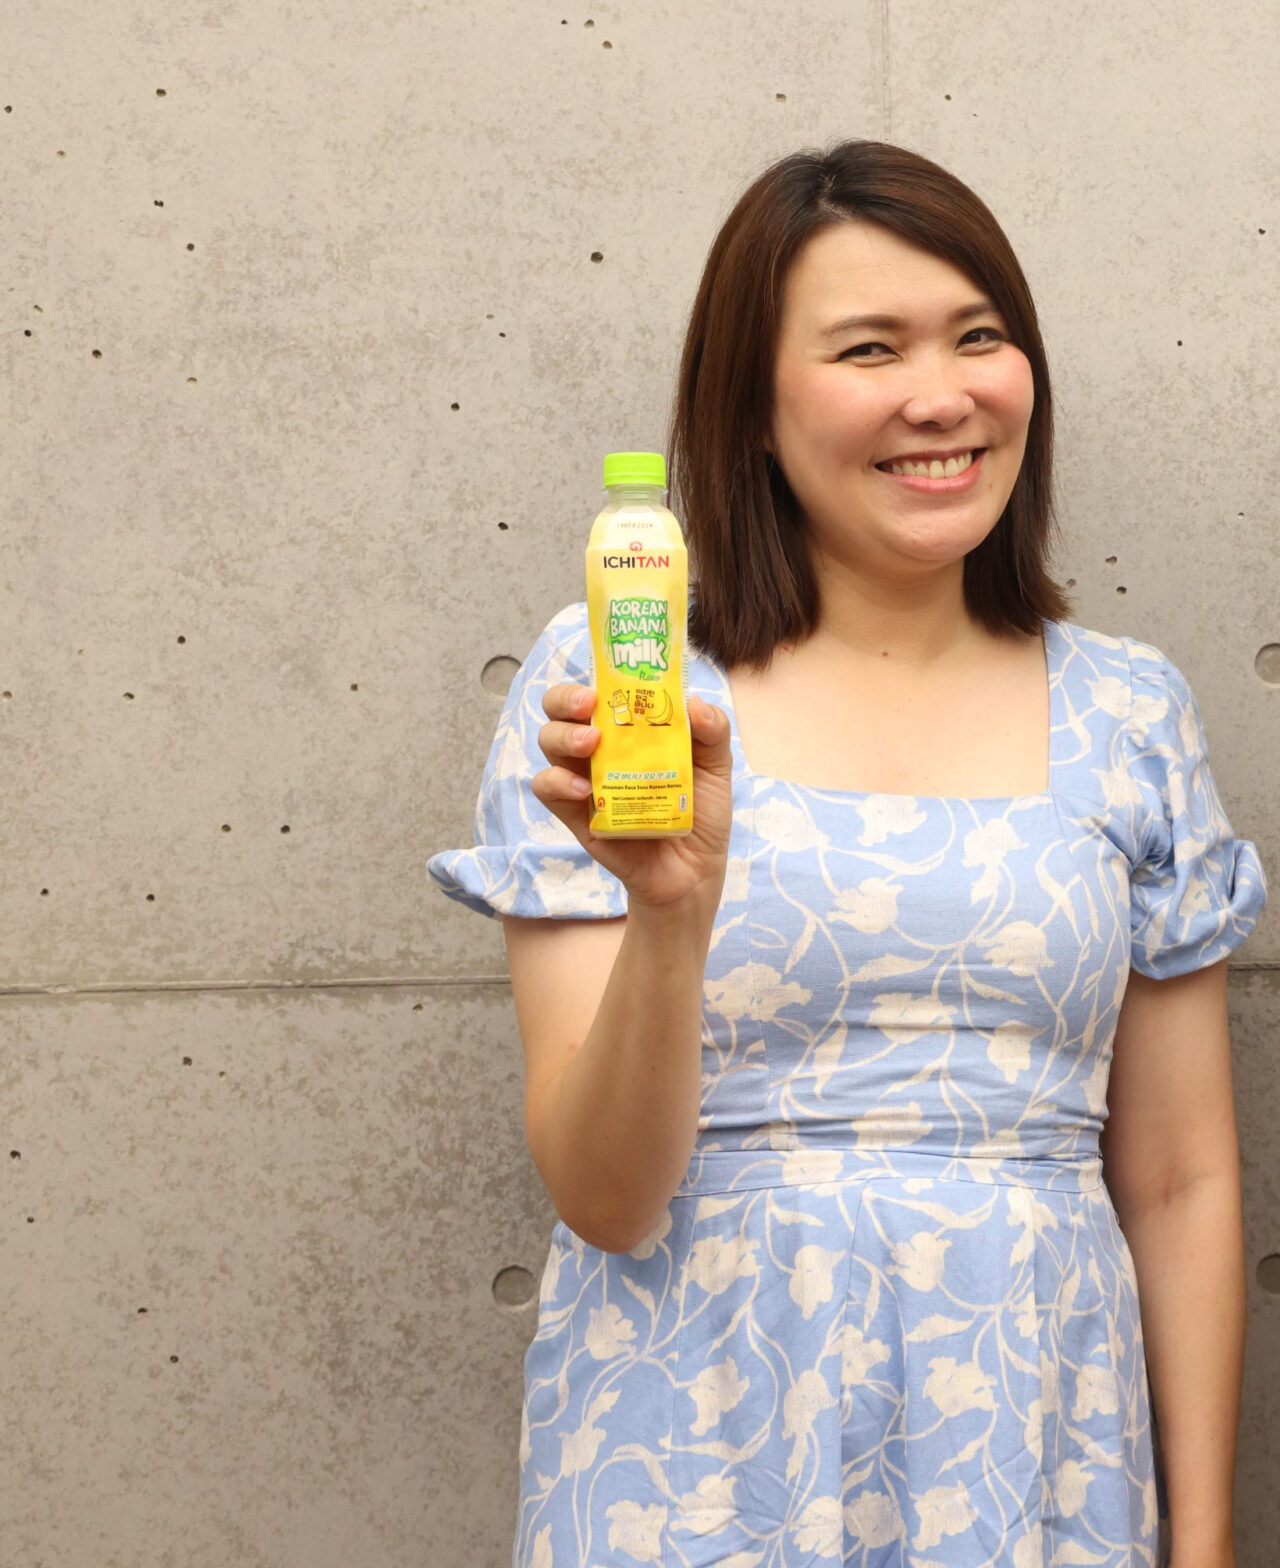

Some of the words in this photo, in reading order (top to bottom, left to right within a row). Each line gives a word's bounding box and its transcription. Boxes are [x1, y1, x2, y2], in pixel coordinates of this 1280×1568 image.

[603, 555, 670, 569] ICHITAN
[611, 600, 667, 618] KOREAN
[610, 616, 667, 637] BANANA
[612, 638, 668, 671] milk
